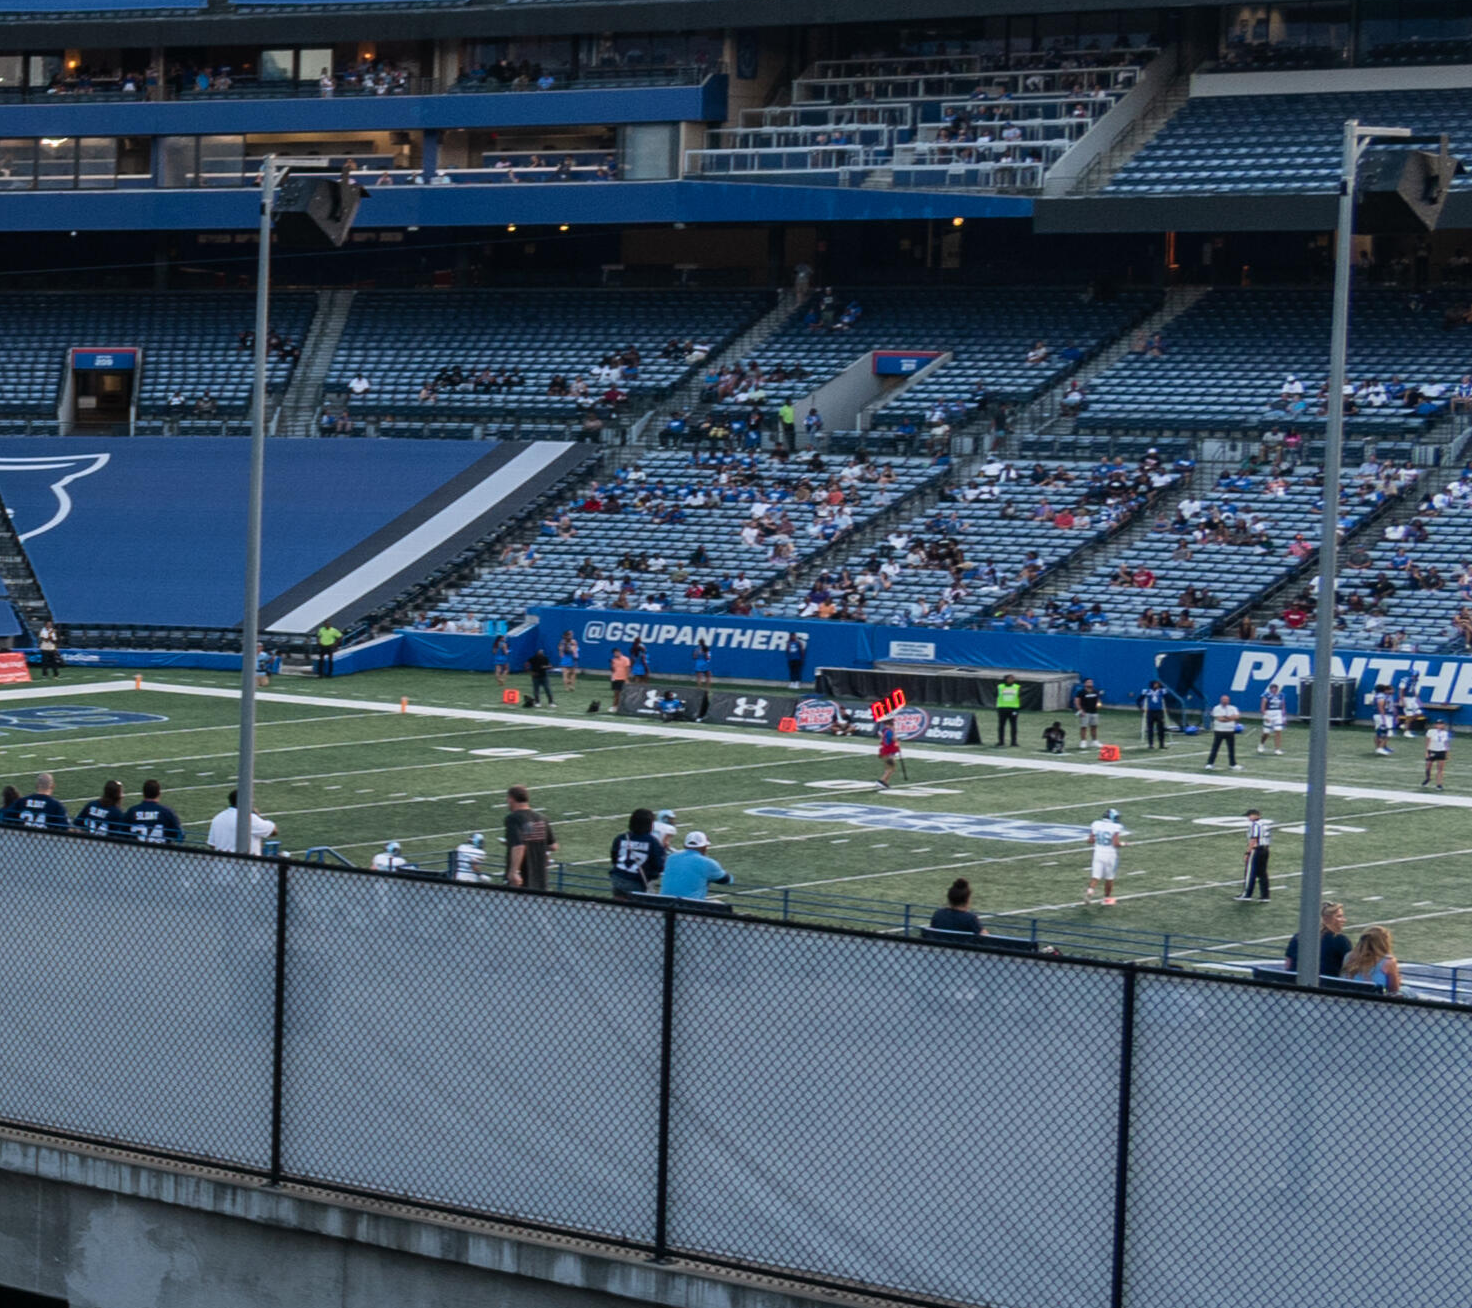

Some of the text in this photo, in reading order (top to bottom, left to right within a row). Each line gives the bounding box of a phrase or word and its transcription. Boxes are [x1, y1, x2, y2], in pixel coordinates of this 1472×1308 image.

[931, 715, 964, 728] a sub
[925, 727, 963, 739] above
